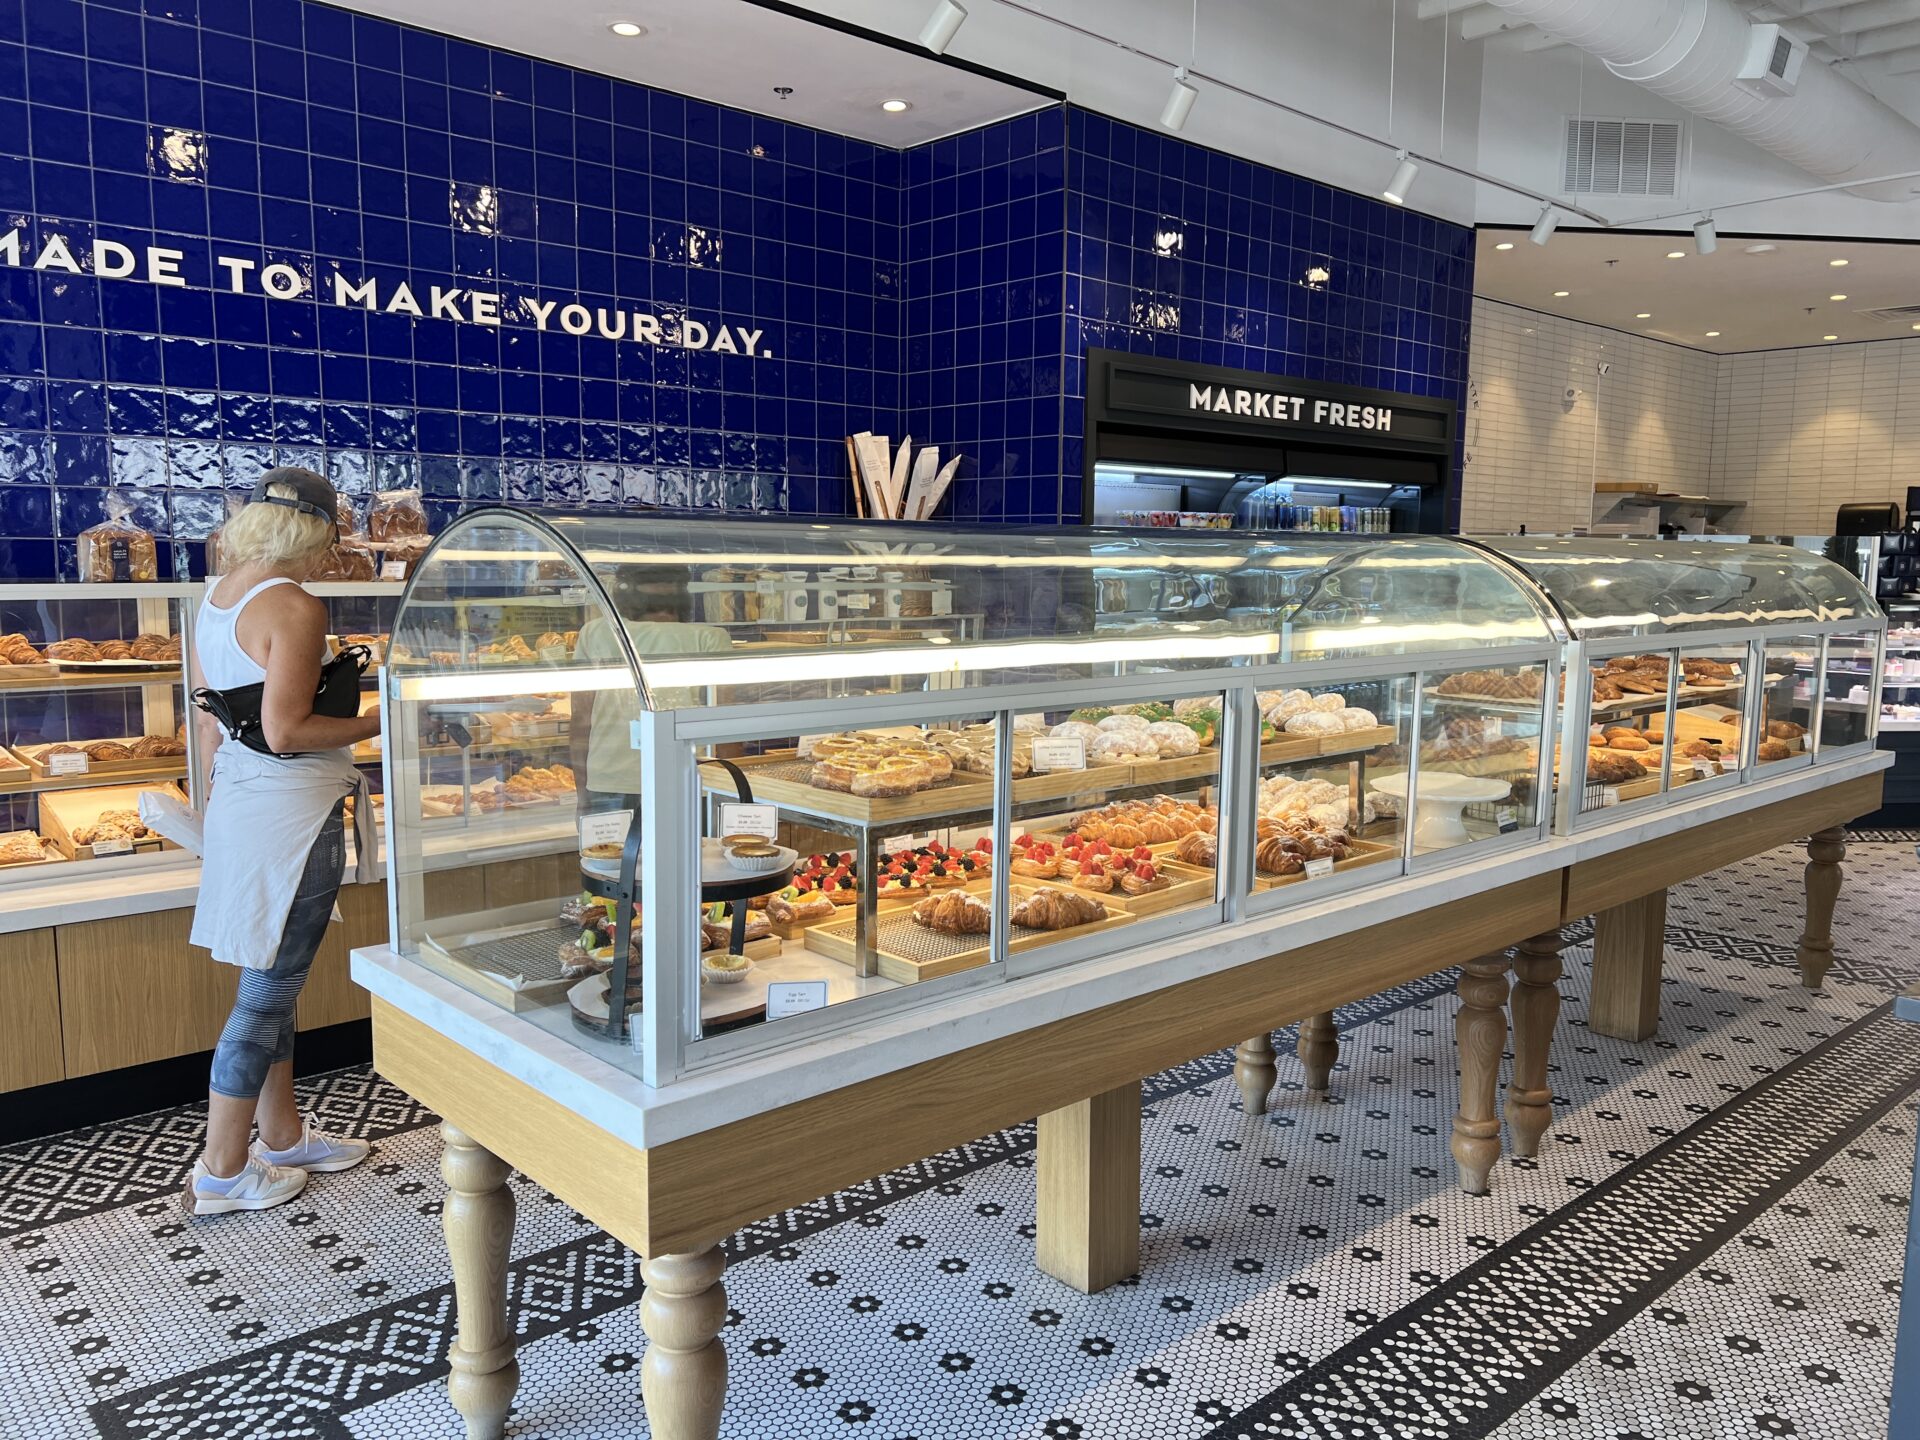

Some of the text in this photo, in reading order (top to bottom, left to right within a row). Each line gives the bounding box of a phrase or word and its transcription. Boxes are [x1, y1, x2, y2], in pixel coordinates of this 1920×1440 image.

[218, 256, 302, 300] TO
[335, 271, 501, 326] MAKE
[526, 299, 661, 345] YOUR
[682, 319, 772, 359] DAY.
[1189, 383, 1392, 432] MARKET FRESH
